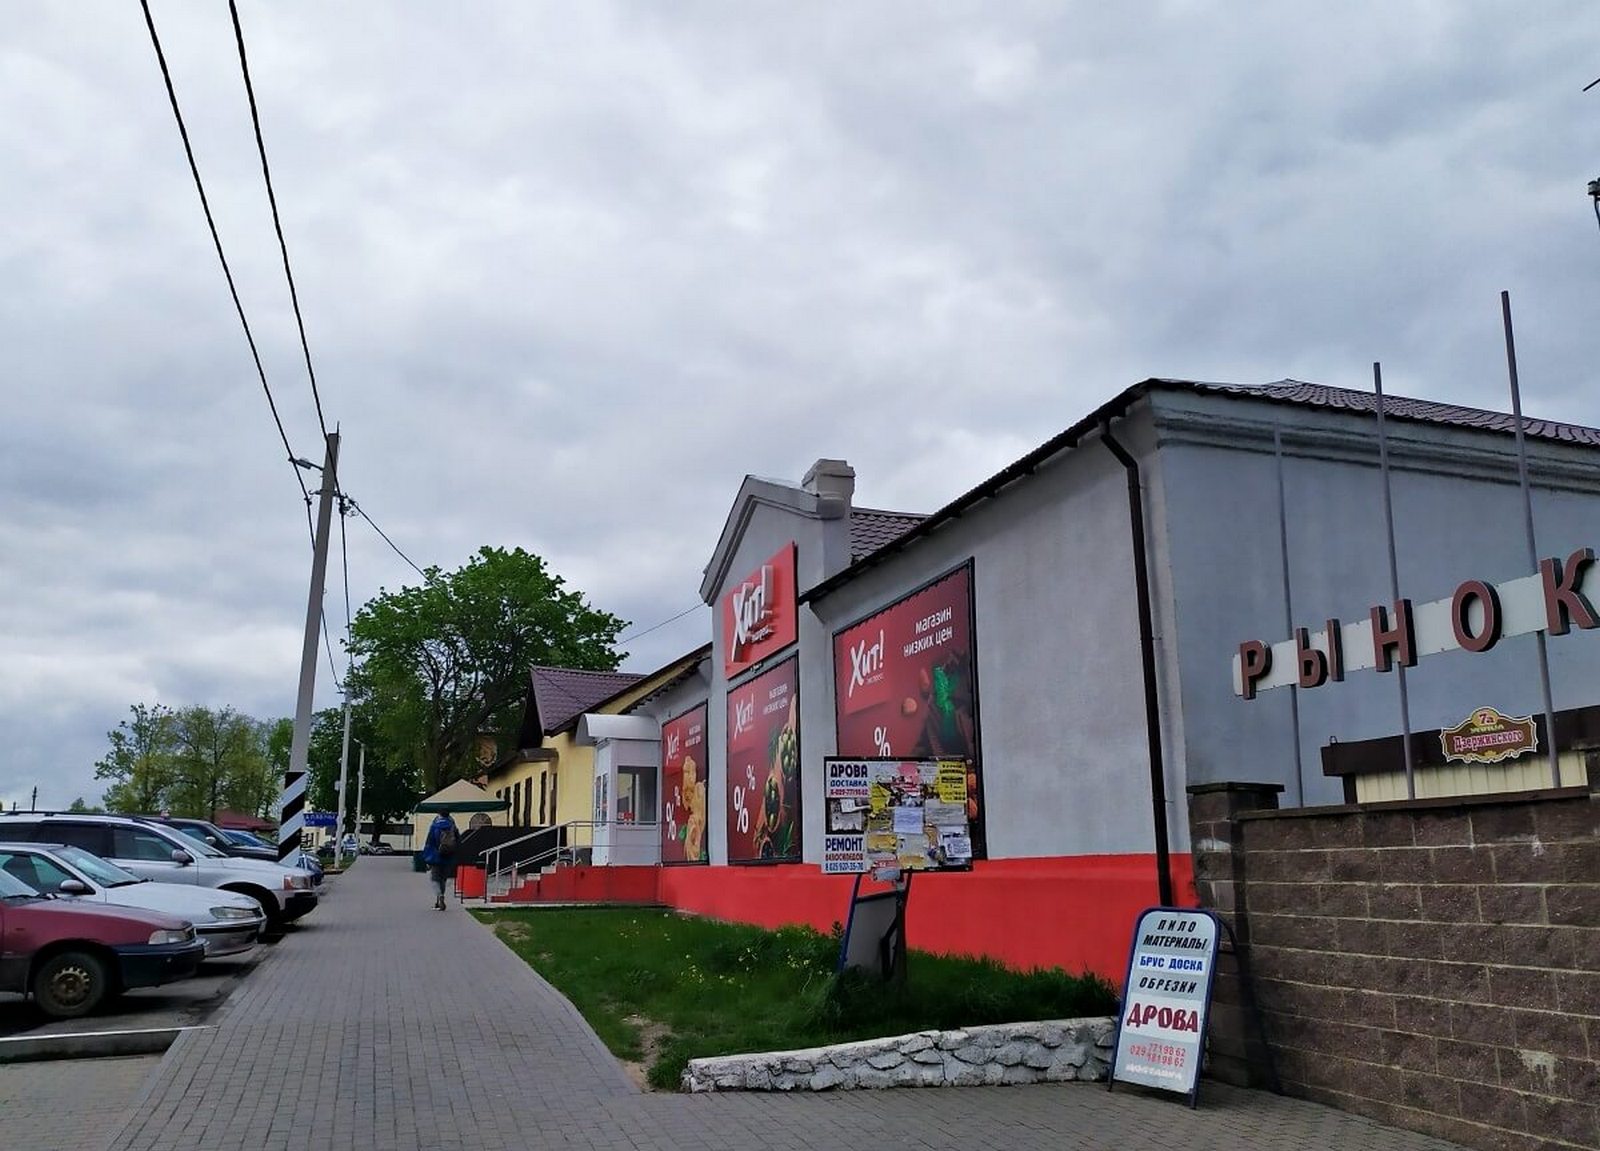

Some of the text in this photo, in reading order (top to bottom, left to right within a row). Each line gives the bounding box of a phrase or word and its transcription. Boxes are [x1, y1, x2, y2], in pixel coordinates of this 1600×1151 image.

[915, 606, 952, 634] магазин
[1239, 547, 1600, 700] РЫНОК
[903, 626, 953, 658] низких цен
[848, 628, 884, 698] Хит!
[1479, 713, 1494, 724] 7а
[1453, 730, 1525, 753] Дзержинского
[830, 763, 868, 778] ДРОВА
[830, 779, 868, 788] ДОСТАВКА
[825, 837, 863, 851] РЕМОНТ
[1157, 919, 1197, 933] ПИЛО
[1142, 934, 1208, 950] МАТЕРИАЛЫ
[1139, 955, 1203, 972] БРУС ДОСКА
[1139, 976, 1197, 994] ОБРЕЗКИ
[1126, 1002, 1198, 1033] ДРОВА
